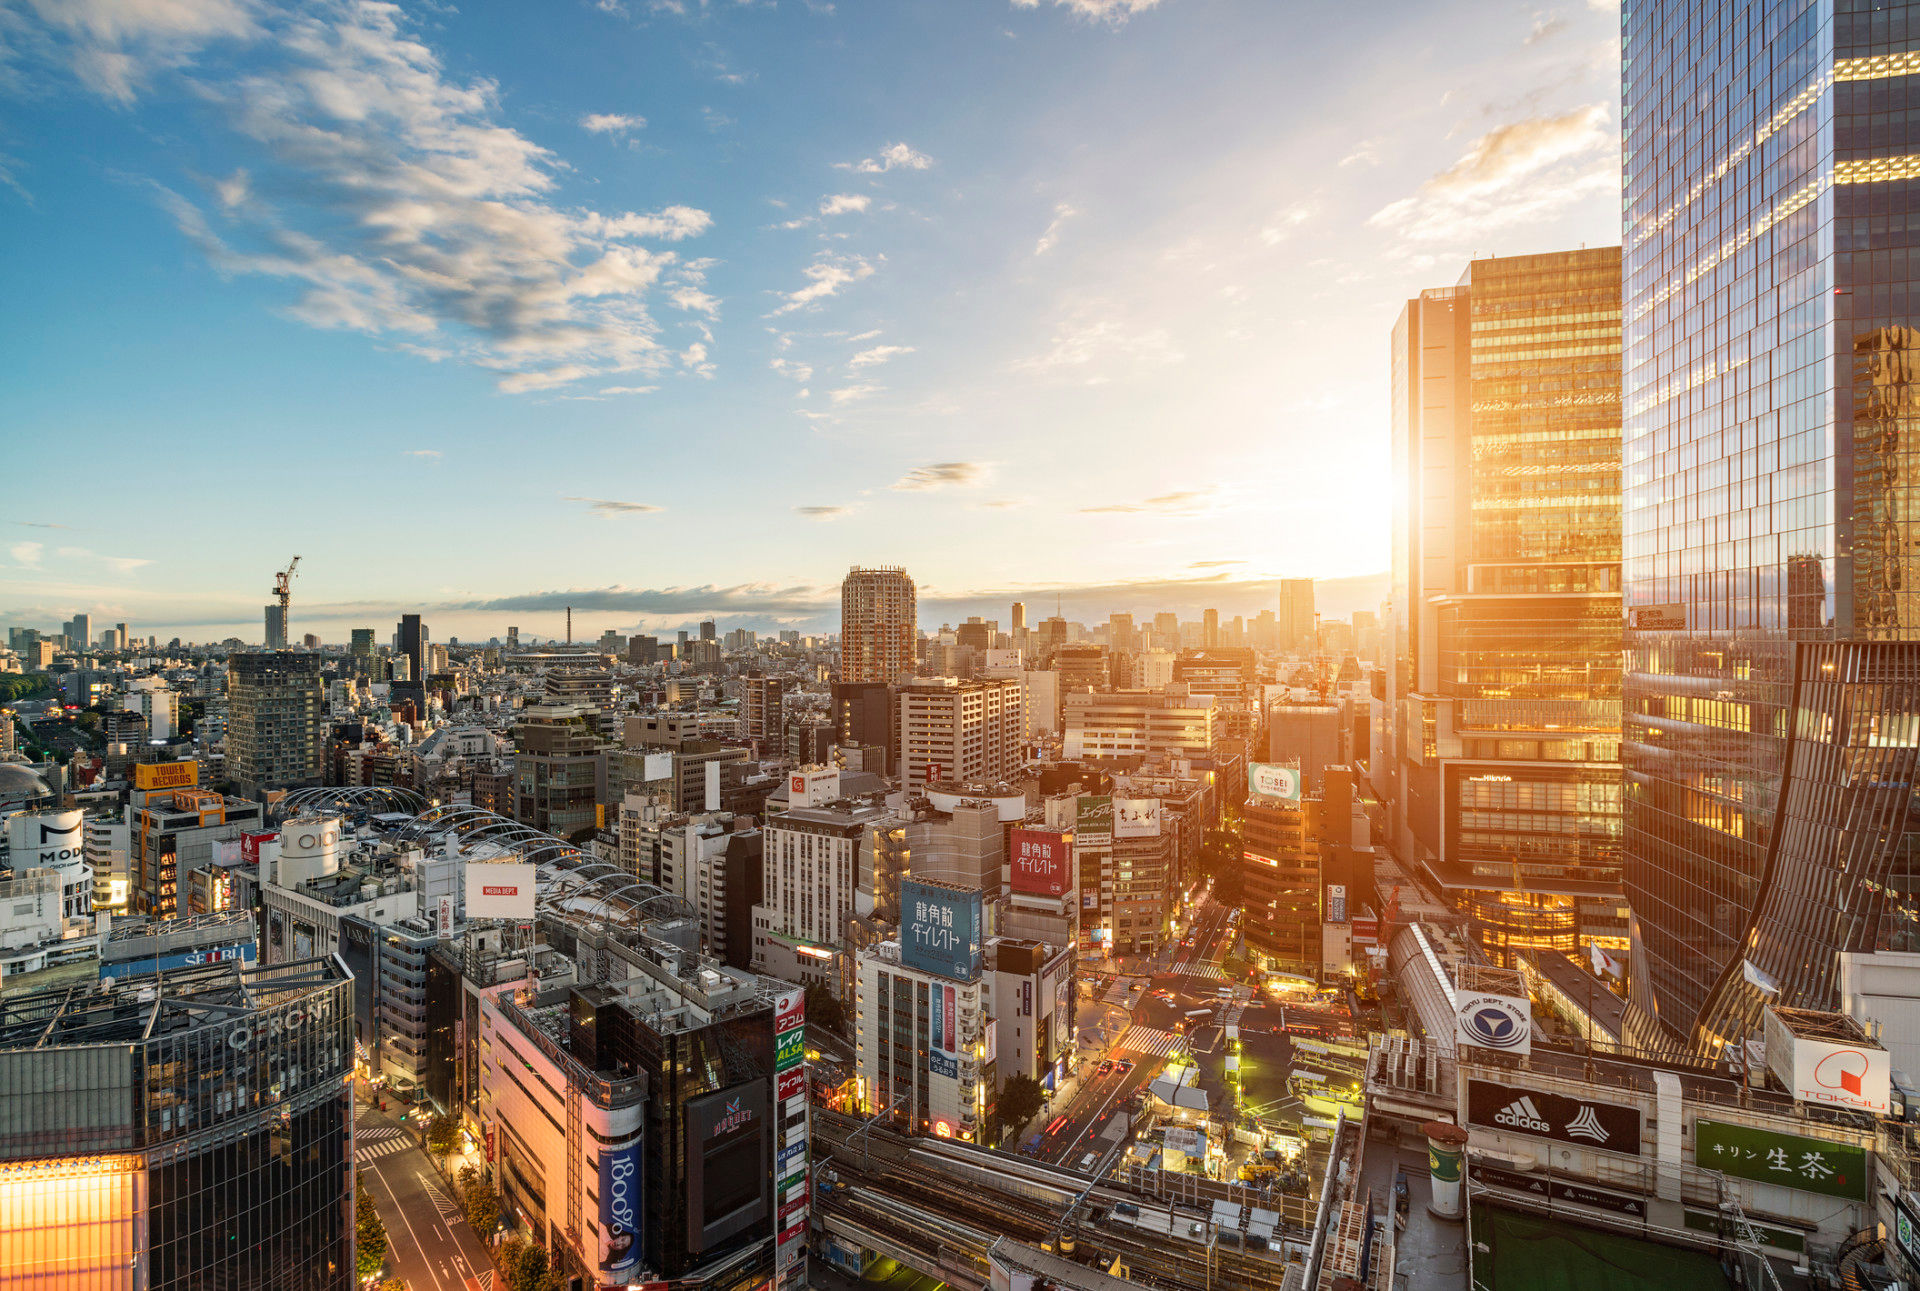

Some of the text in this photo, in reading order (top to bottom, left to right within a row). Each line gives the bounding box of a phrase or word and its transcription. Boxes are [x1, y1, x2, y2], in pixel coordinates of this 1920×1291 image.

[155, 764, 185, 776] TOWER
[152, 774, 191, 787] RECORDS
[916, 900, 953, 928] 龍角散
[911, 922, 960, 951] ダイレクト
[1461, 998, 1527, 1022] TOKYU DEPT. STORE
[779, 1014, 803, 1030] アコム
[778, 1031, 803, 1049] レイク
[777, 1043, 803, 1061] ALSA
[780, 1075, 803, 1091] アイフル
[1799, 1089, 1885, 1110] TOKYU
[1495, 1112, 1550, 1132] adidas
[611, 1155, 635, 1235] 1800%
